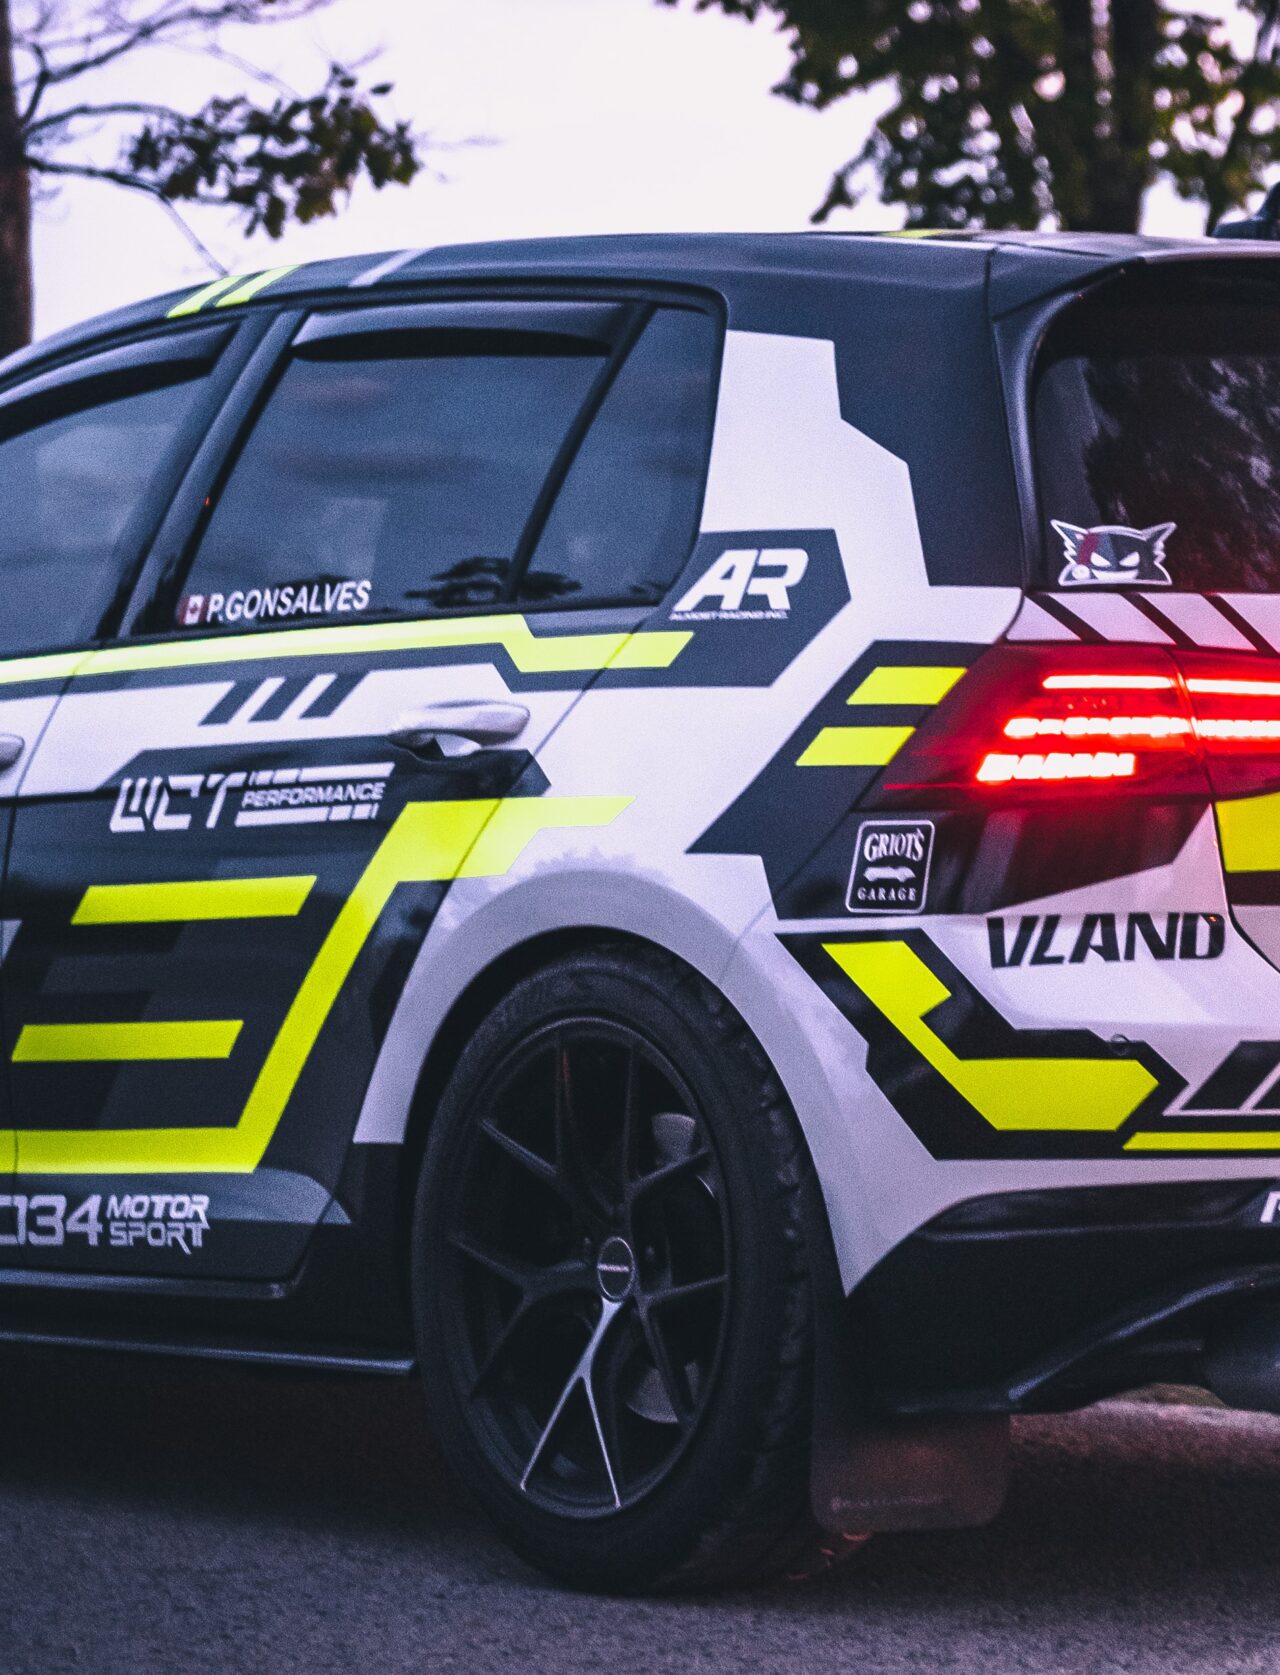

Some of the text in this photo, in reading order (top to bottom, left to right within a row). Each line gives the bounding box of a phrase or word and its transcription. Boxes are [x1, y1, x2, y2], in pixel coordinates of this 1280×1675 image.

[672, 548, 809, 611] AR
[242, 782, 386, 808] PERFORMANCE
[857, 886, 917, 901] GARAGE
[986, 911, 1225, 969] VLAND
[106, 1194, 210, 1230] MOTOR
[108, 1221, 204, 1255] SPORT
